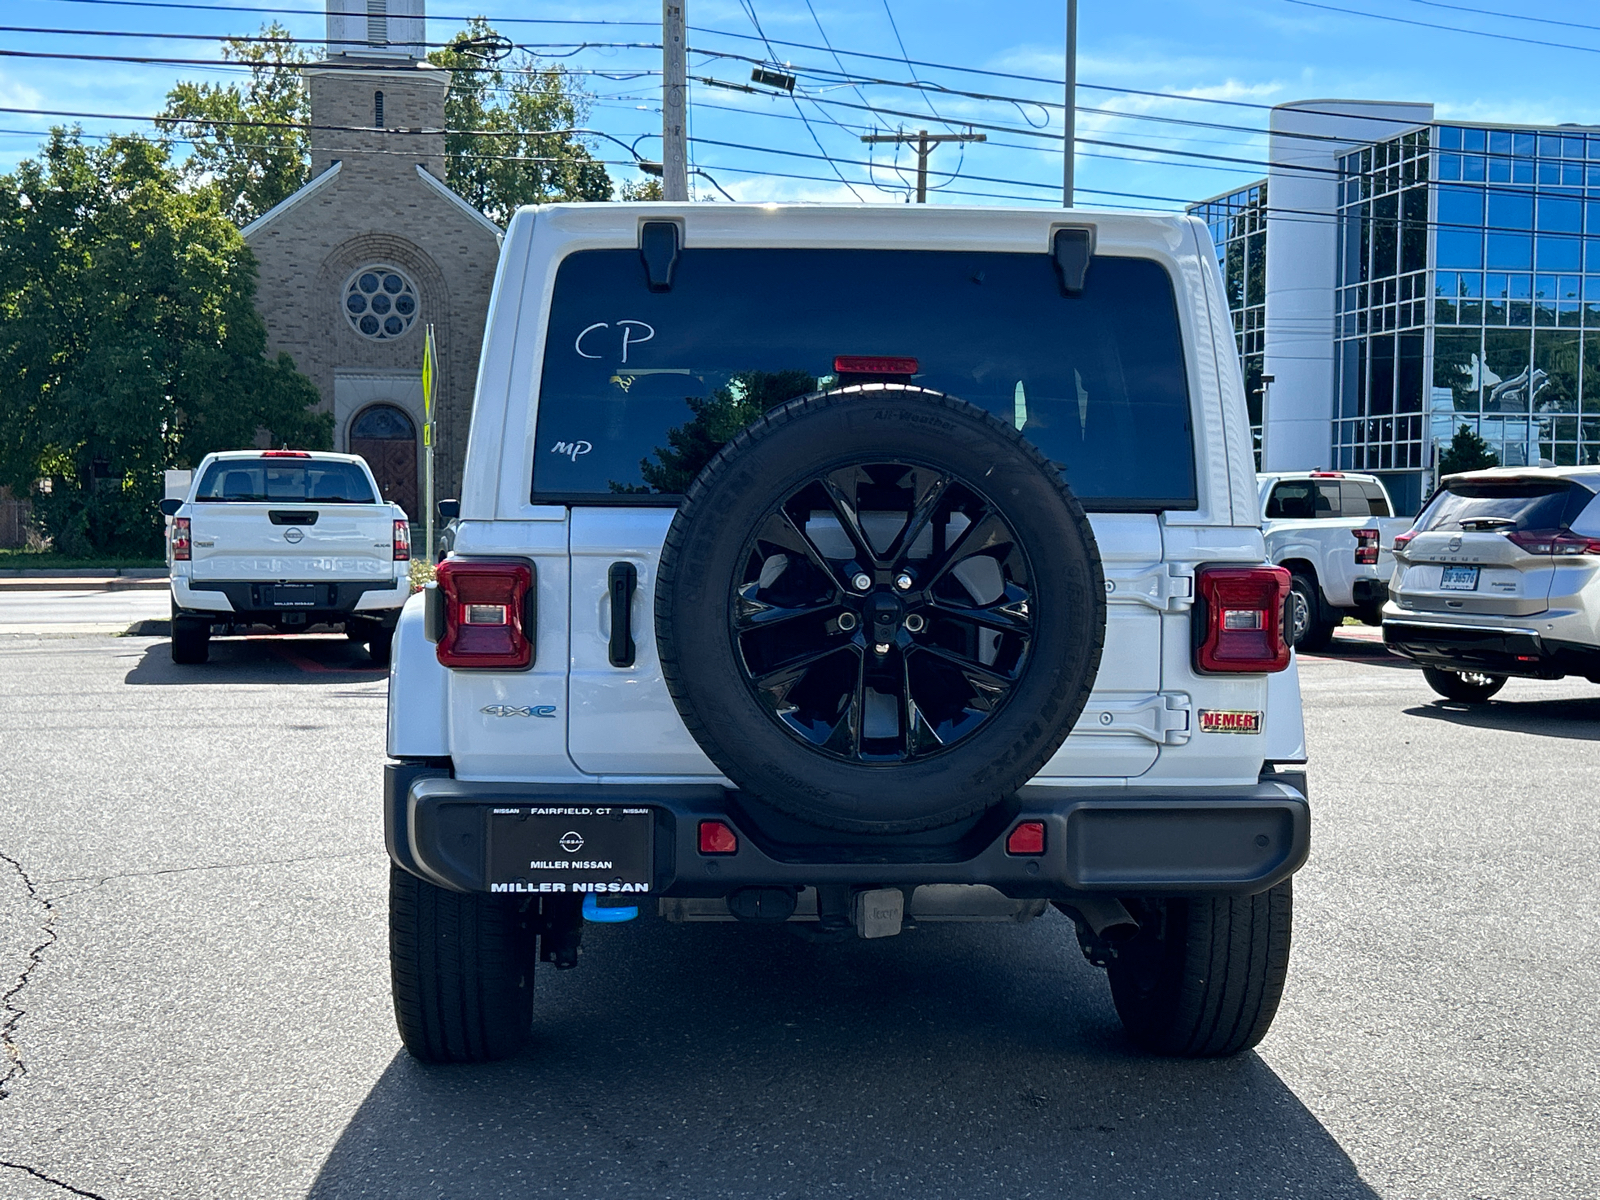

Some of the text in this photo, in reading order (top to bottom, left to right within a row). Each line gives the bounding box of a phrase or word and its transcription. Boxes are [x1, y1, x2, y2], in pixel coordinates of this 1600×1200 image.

[575, 319, 655, 363] CP
[873, 409, 958, 432] All-Weather
[530, 808, 593, 816] FAIRFIELD,
[530, 861, 612, 869] MILLER NISSAN
[491, 883, 649, 892] MILLER NISSAN
